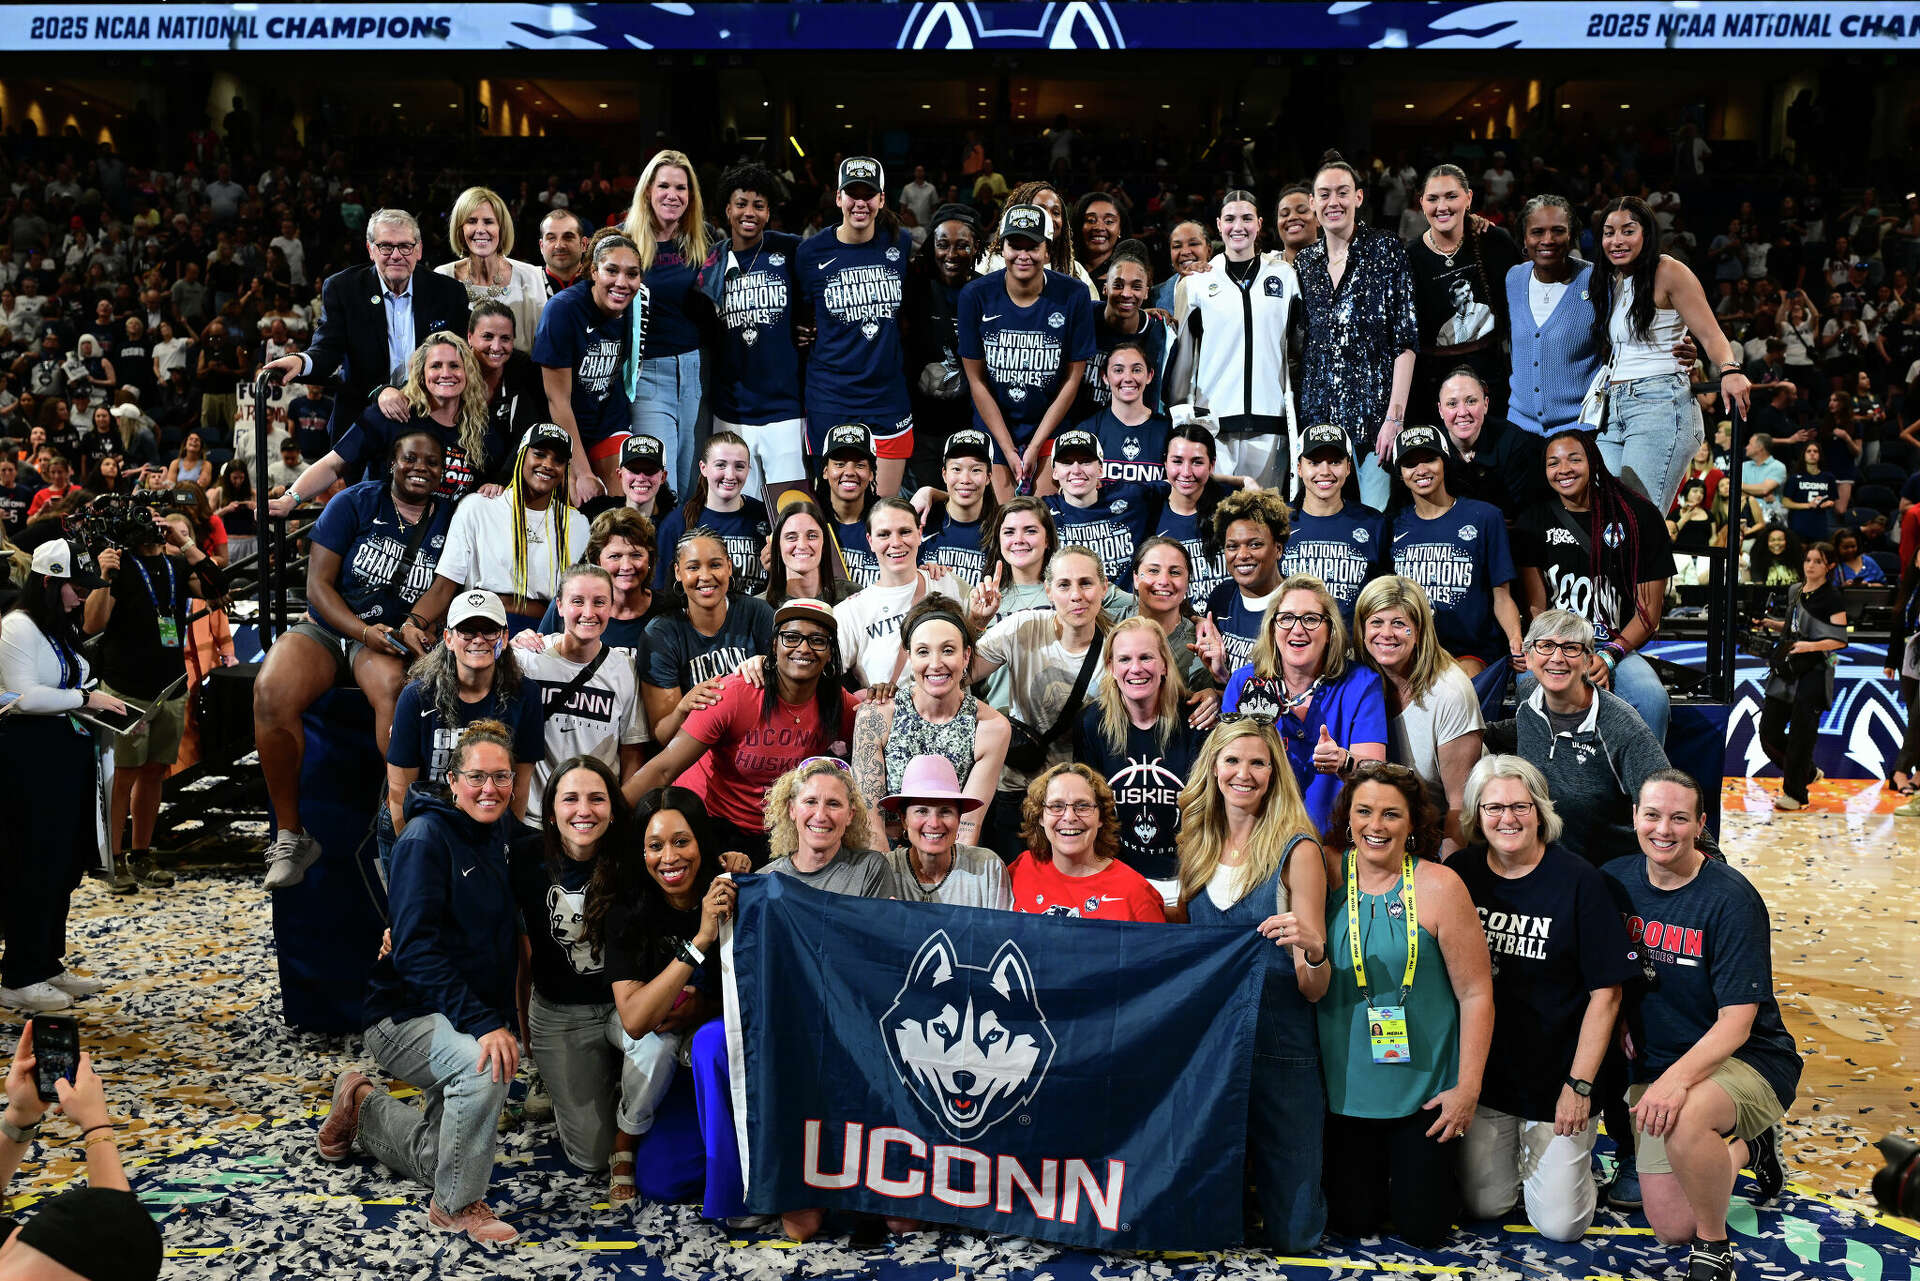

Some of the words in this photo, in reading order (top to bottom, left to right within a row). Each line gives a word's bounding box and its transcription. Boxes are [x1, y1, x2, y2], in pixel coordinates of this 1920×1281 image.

[31, 16, 88, 39] 2025
[95, 16, 149, 39] NCAA
[157, 16, 258, 39] NATIONAL
[266, 16, 452, 39] CHAMPIONS
[1587, 14, 1651, 37] 2025
[1656, 14, 1716, 37] NCAA
[1722, 14, 1831, 37] NATIONAL
[726, 273, 767, 292] NATIONAL
[841, 267, 885, 285] NATIONAL
[725, 285, 787, 313] AMPIONS
[824, 280, 902, 309] CHAMPIONS
[727, 309, 770, 329] HUSKIES
[845, 302, 892, 322] HUSKIES
[999, 333, 1045, 348] NATIONAL
[984, 345, 1062, 371] HAMPIONS
[996, 370, 1042, 387] HUSKIES
[1065, 523, 1113, 541] NATIONAL
[938, 550, 983, 570] NATIONAL
[1300, 544, 1350, 560] NATIONAL
[1405, 546, 1453, 562] NATIONAL
[1423, 585, 1450, 605] KIES
[689, 646, 748, 685] UCONN
[746, 728, 824, 748] UCONN
[1572, 741, 1597, 757] UCONN
[736, 750, 803, 772] HUSK
[1485, 930, 1547, 960] ETBALL
[803, 1119, 1126, 1231] UCONN
